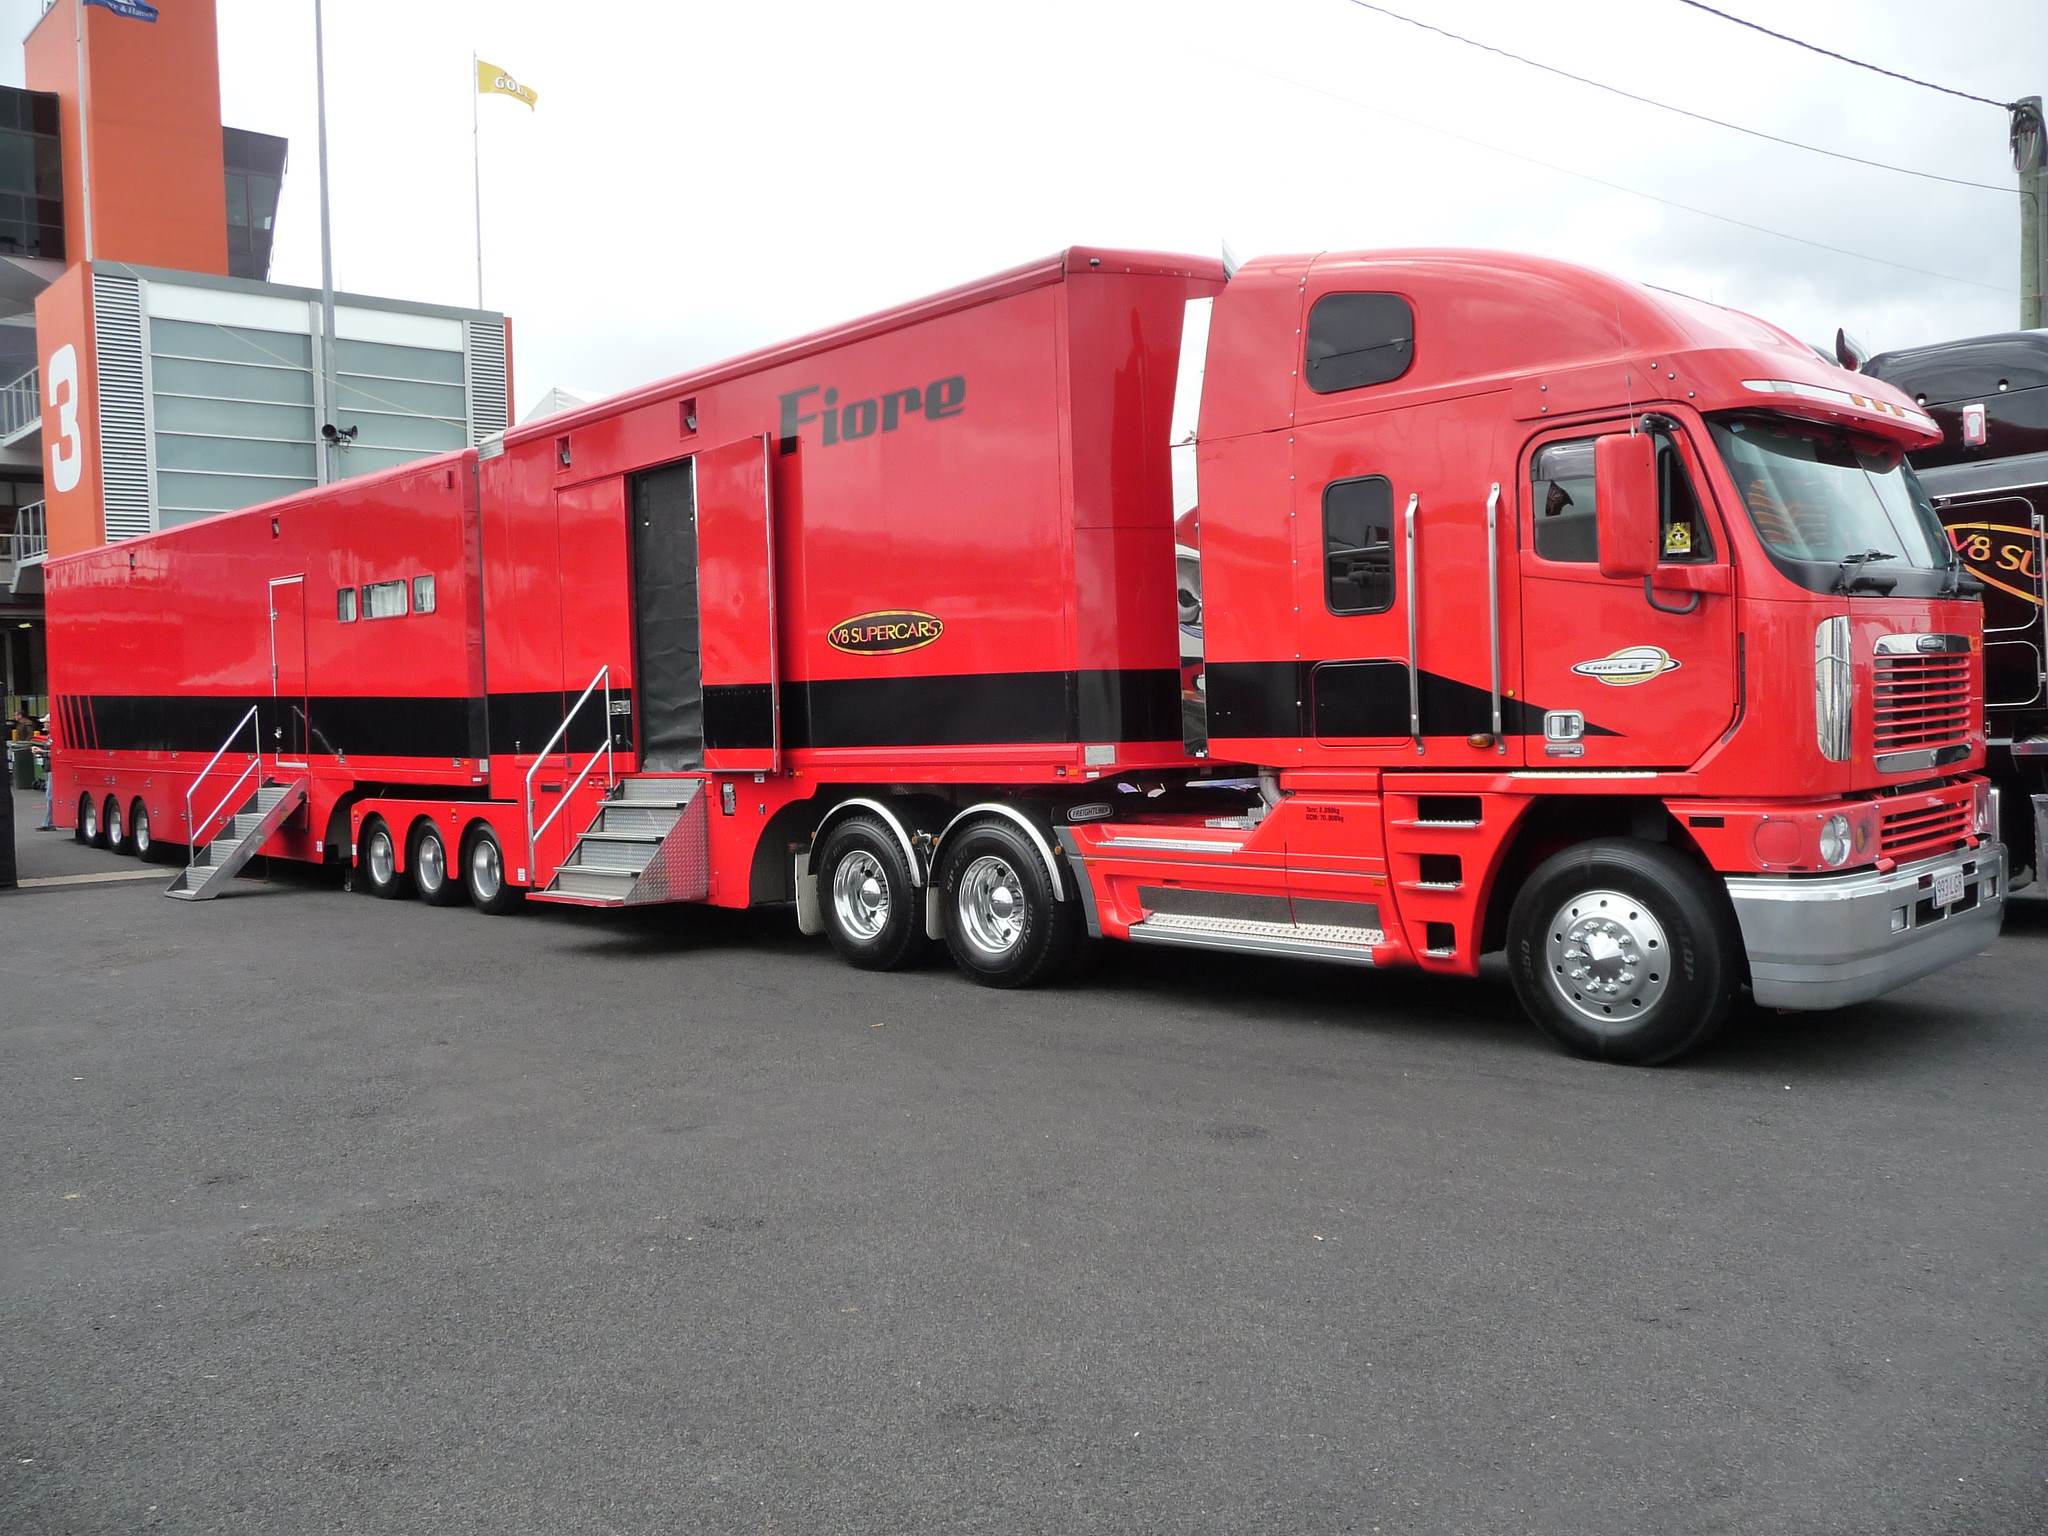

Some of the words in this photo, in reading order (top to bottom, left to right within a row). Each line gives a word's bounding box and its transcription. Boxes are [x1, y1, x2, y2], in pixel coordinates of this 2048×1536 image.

[48, 343, 82, 493] 3
[778, 374, 966, 456] Fiore
[1947, 528, 1991, 561] V8
[831, 628, 850, 644] V8
[851, 619, 943, 643] SUPERCARS
